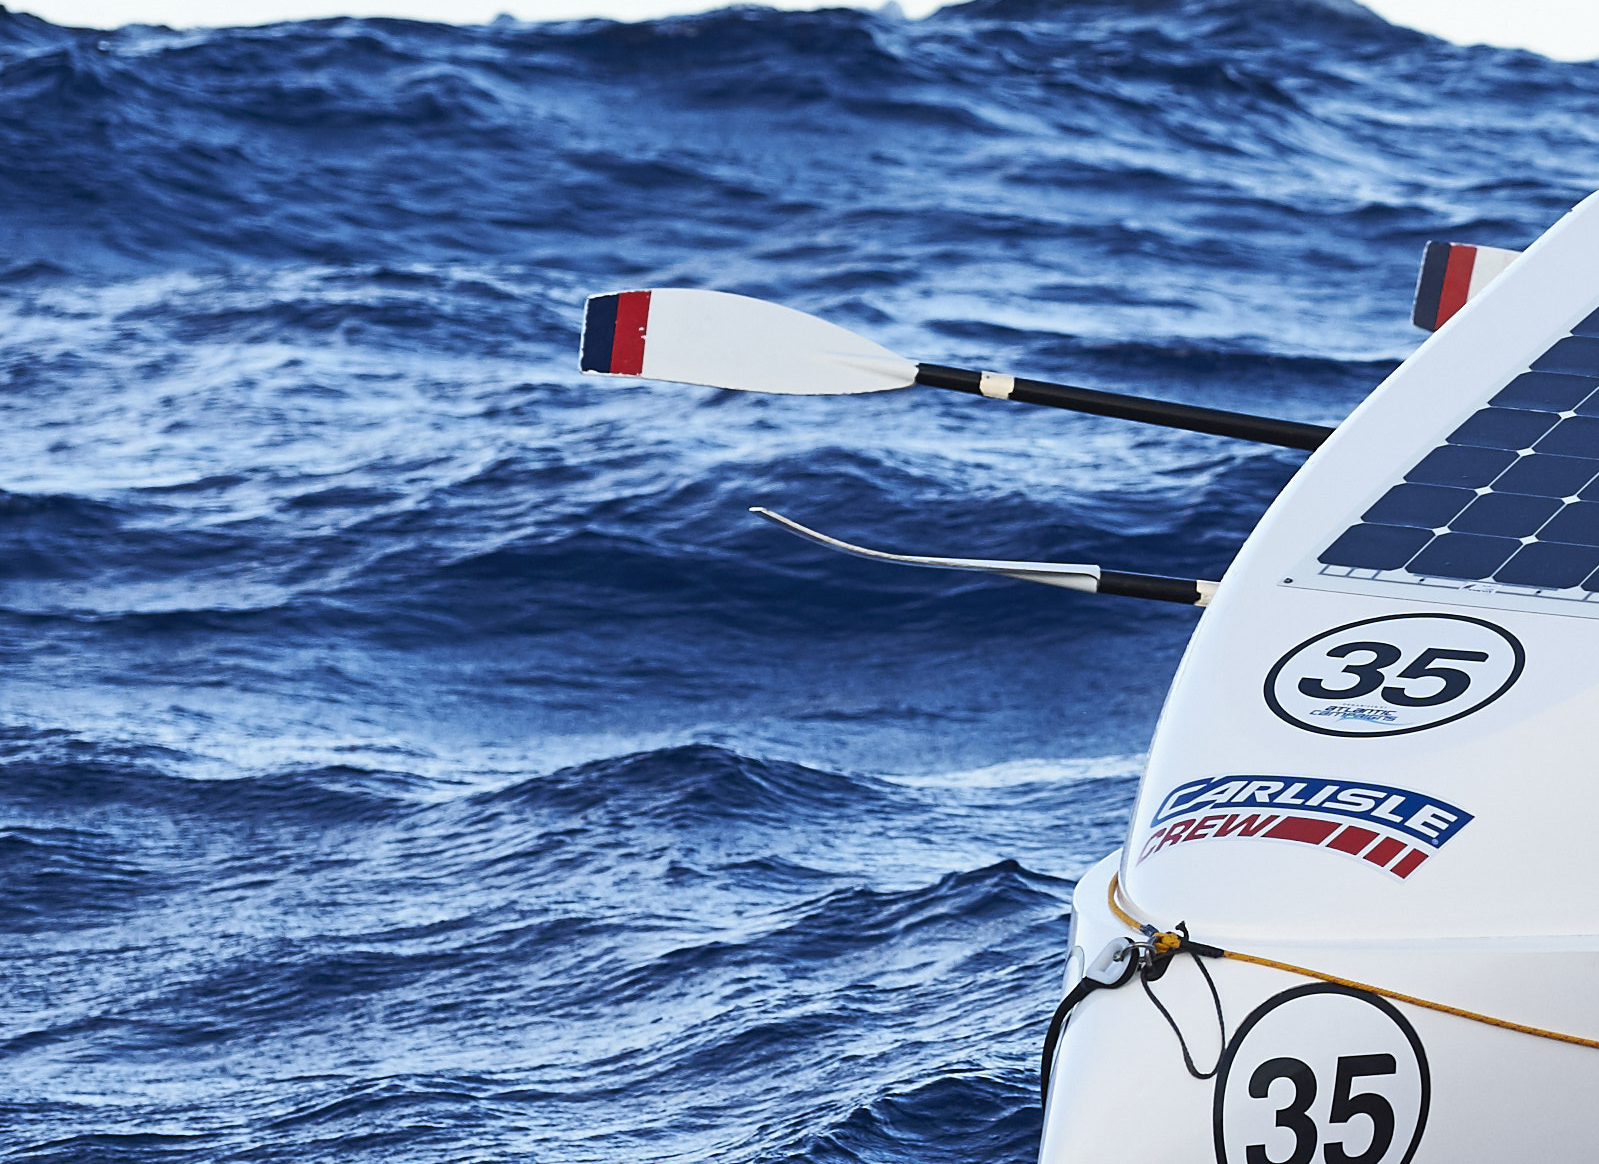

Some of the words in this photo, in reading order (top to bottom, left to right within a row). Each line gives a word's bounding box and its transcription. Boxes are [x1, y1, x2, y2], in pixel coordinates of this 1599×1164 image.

[1297, 641, 1489, 707] 35
[1135, 812, 1282, 868] CREW
[1156, 779, 1459, 839] CARLISLE
[1246, 1053, 1397, 1164] 35
